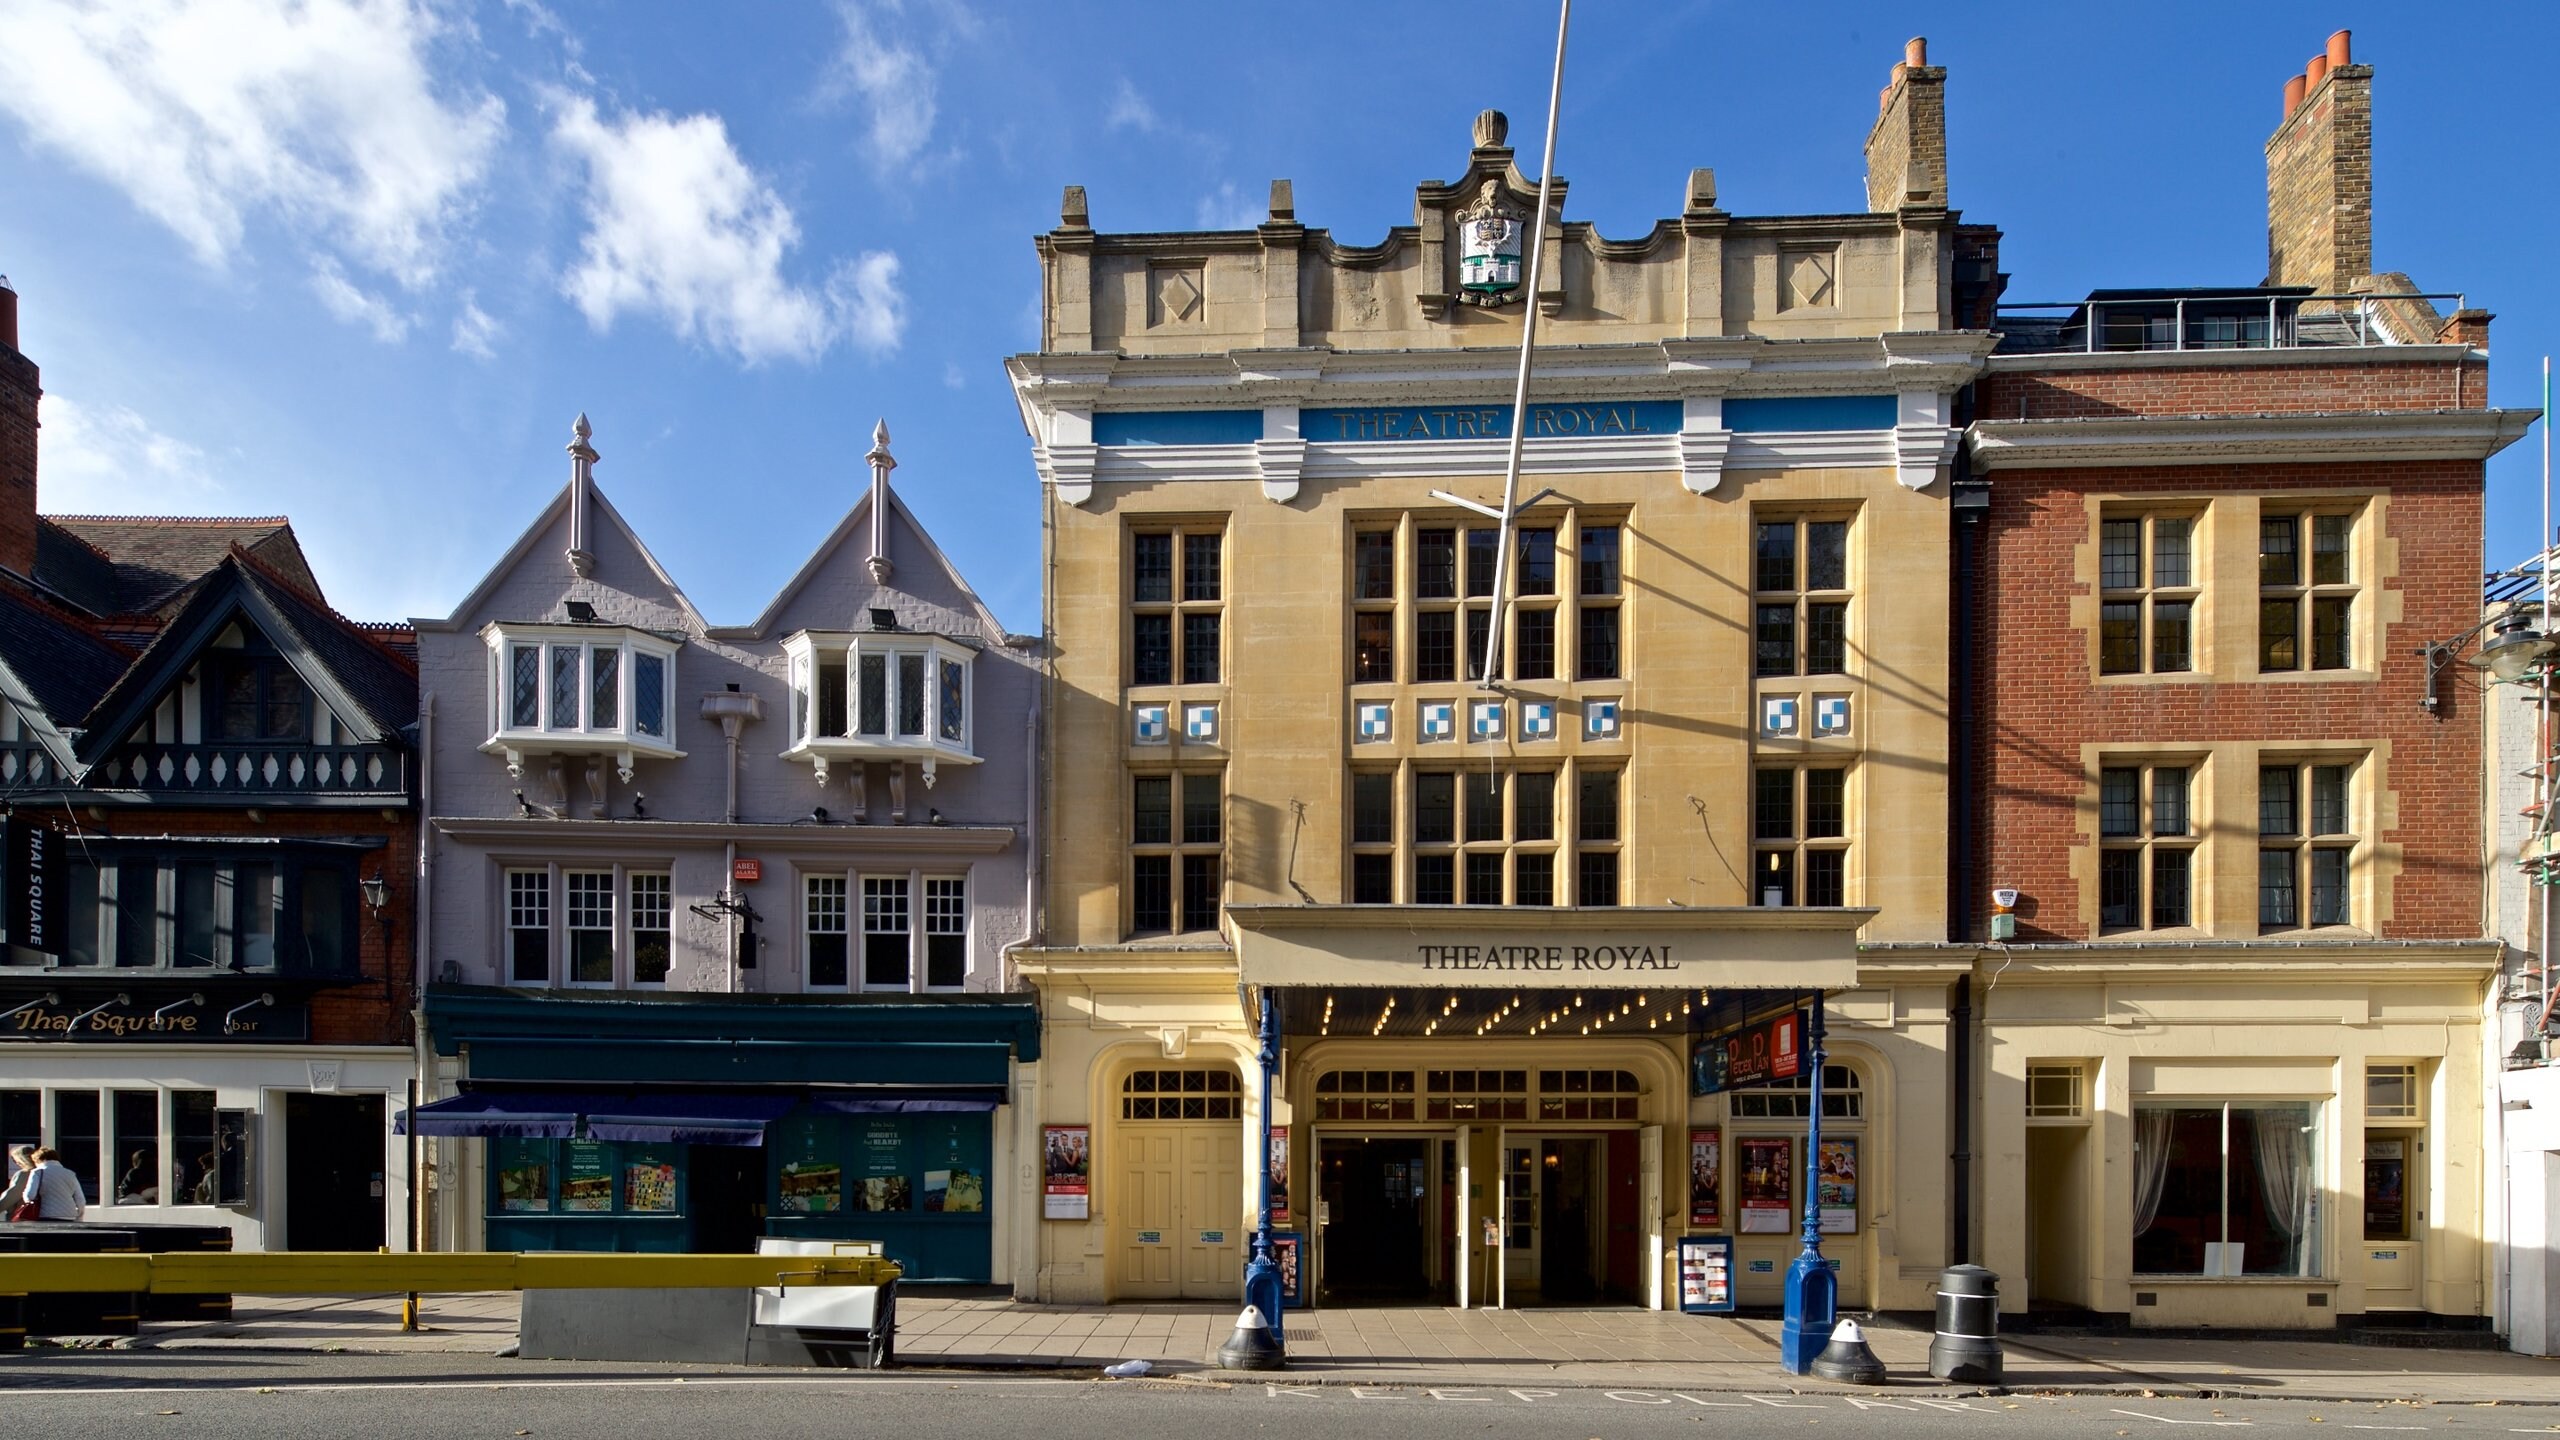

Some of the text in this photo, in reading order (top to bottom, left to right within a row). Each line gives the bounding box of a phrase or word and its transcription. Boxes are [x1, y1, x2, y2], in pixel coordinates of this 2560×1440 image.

[1332, 407, 1650, 439] THEATRE ROYAL
[737, 862, 756, 870] ABEL
[29, 829, 43, 946] THAI SQUARE
[1418, 945, 1680, 970] THEATRE ROYAL
[90, 1011, 198, 1036] Square
[231, 1018, 258, 1031] bar
[1266, 1382, 2000, 1413] KEEP CLEAR
